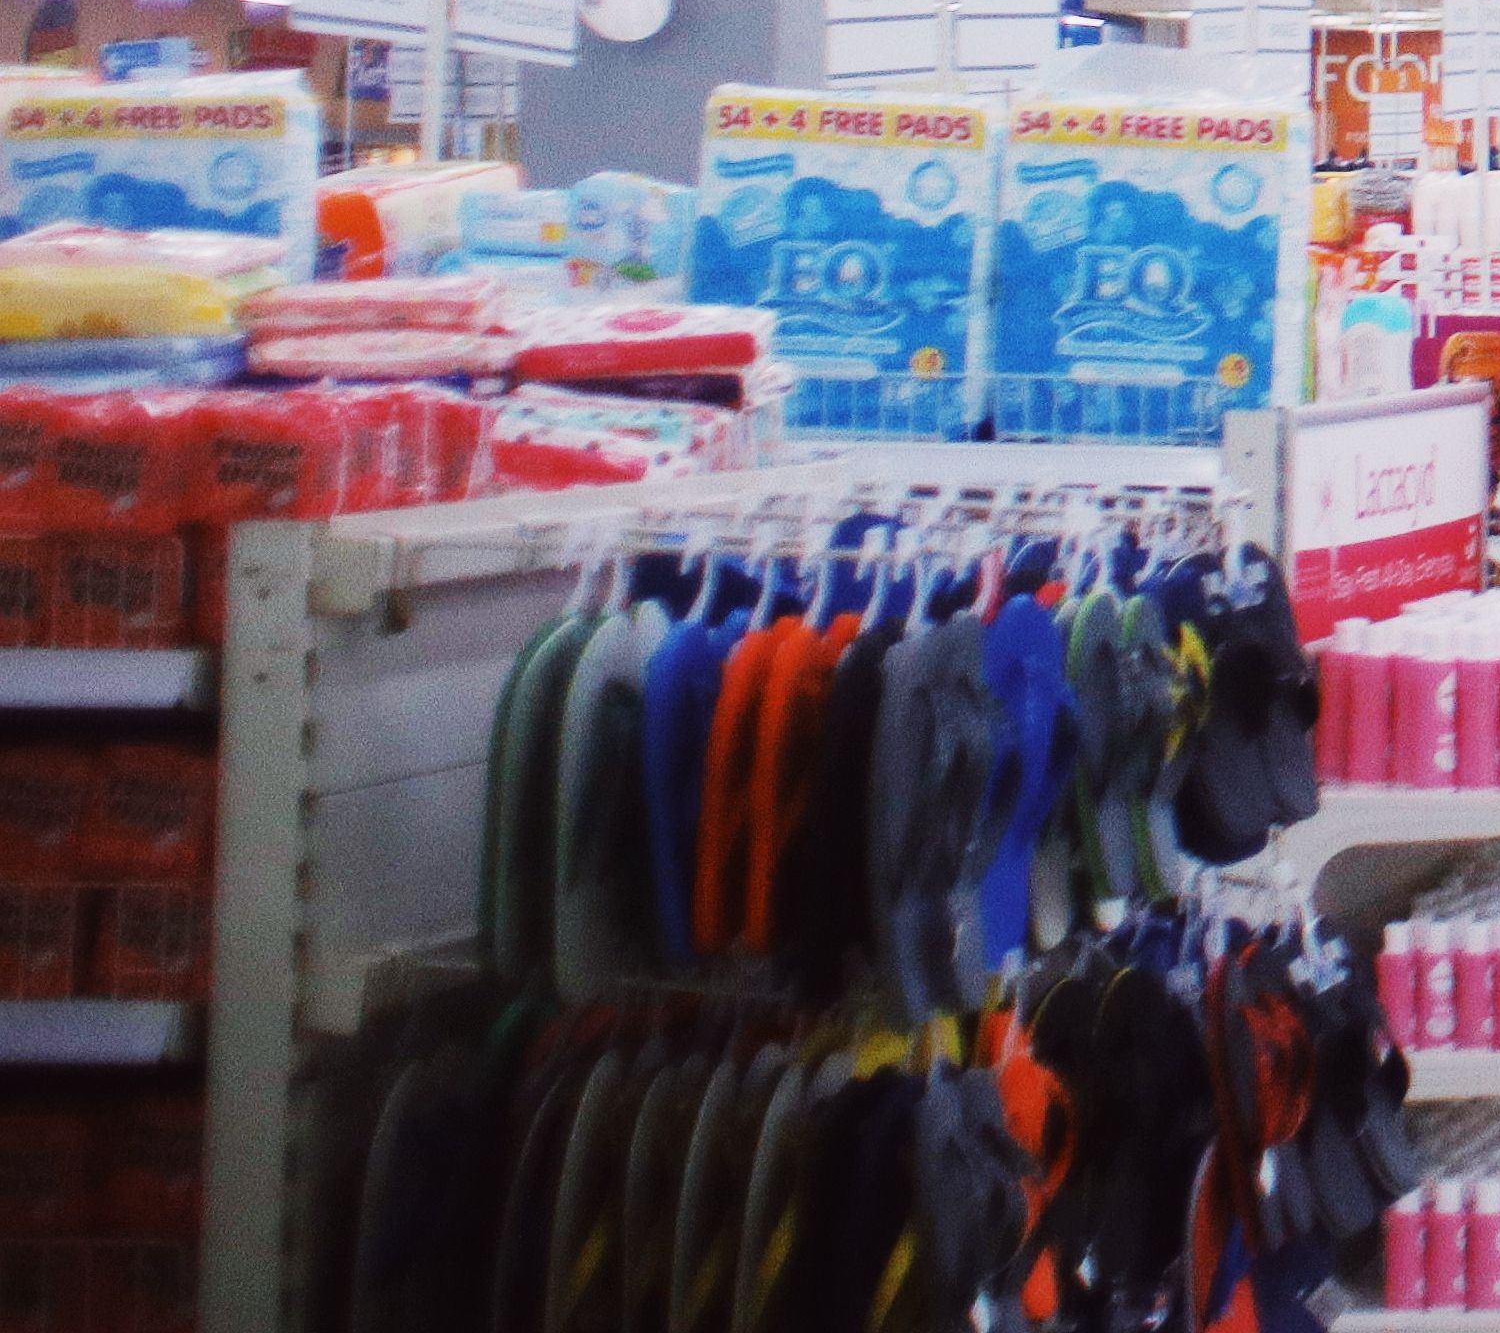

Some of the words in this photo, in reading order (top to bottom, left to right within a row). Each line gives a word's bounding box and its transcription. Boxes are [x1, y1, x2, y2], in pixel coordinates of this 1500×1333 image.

[112, 105, 183, 130] FREE
[192, 103, 274, 130] PADS
[716, 105, 752, 131] 54
[787, 109, 808, 132] 4
[818, 109, 884, 138] FREE
[894, 112, 973, 143] PADS
[1016, 109, 1054, 134] 54
[1087, 112, 1108, 137] 4
[1118, 113, 1187, 140] FREE
[1196, 115, 1276, 145] PADS
